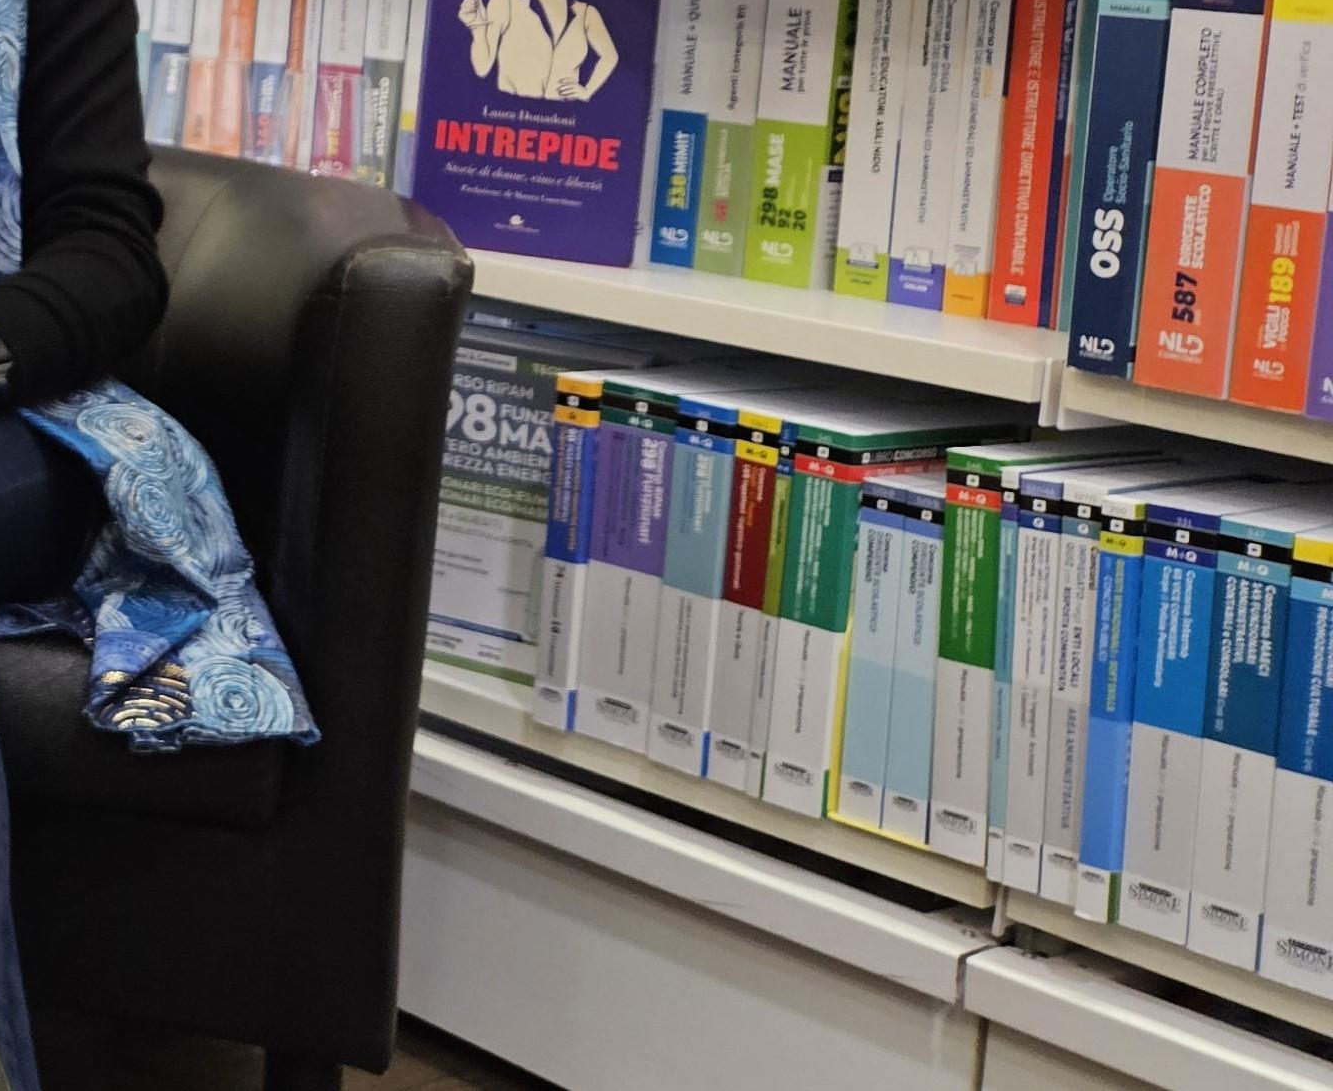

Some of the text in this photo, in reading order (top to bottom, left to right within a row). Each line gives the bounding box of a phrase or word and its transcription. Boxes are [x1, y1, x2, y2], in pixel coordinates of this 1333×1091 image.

[780, 7, 803, 93] MANUALE
[988, 0, 1001, 47] Concorso
[681, 34, 698, 95] MANUALE
[876, 56, 892, 117] EDUCATORI
[1021, 79, 1041, 150] ISTRUTTORE
[1187, 27, 1213, 162] MANUALE COMPLETO
[435, 118, 622, 171] INTREPIDE
[671, 129, 692, 174] MIMIT
[870, 148, 882, 175] NIDO
[1284, 94, 1307, 190] MANUALE TEST
[758, 132, 785, 227] 298 MASE
[1016, 152, 1034, 211] DIRETTIVO
[777, 208, 791, 231] 92
[792, 209, 808, 232] 20
[1010, 213, 1029, 277] CONTABILE
[1090, 207, 1125, 279] OSS
[1178, 194, 1198, 268] DIRIGENTE
[1191, 183, 1213, 270] SCOLASTICO
[1171, 270, 1198, 324] 587
[1269, 256, 1296, 303] 189
[1264, 305, 1281, 350] VIGILI
[499, 420, 553, 455] MA
[893, 447, 938, 461] CONCORSO
[1261, 584, 1276, 639] Concorso
[1305, 605, 1329, 737] PROMOZIONE CULTURALE
